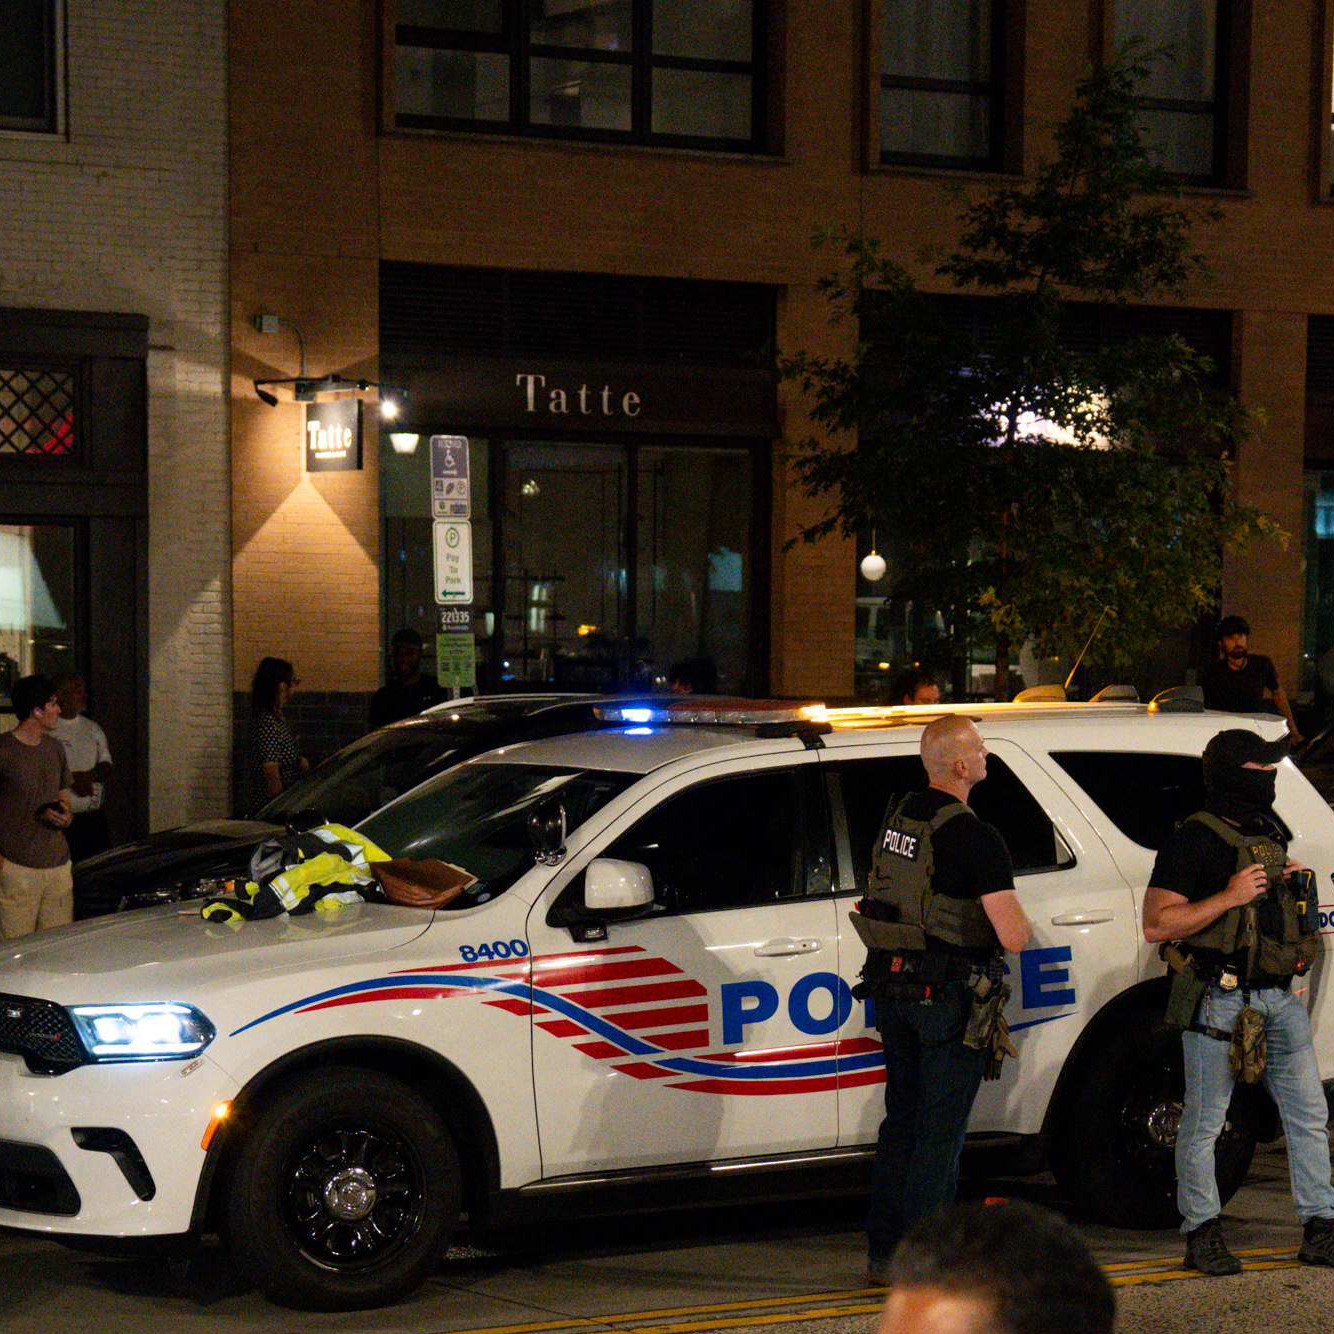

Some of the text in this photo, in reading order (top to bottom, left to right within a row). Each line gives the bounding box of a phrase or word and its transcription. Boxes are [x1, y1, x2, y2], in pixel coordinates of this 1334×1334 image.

[516, 373, 641, 417] Tatte
[307, 420, 352, 450] Tatte
[446, 552, 460, 563] Pay
[449, 565, 459, 574] To
[445, 575, 462, 585] Park
[882, 829, 917, 858] POLICE
[459, 939, 529, 963] 8400
[722, 947, 1076, 1045] POE
